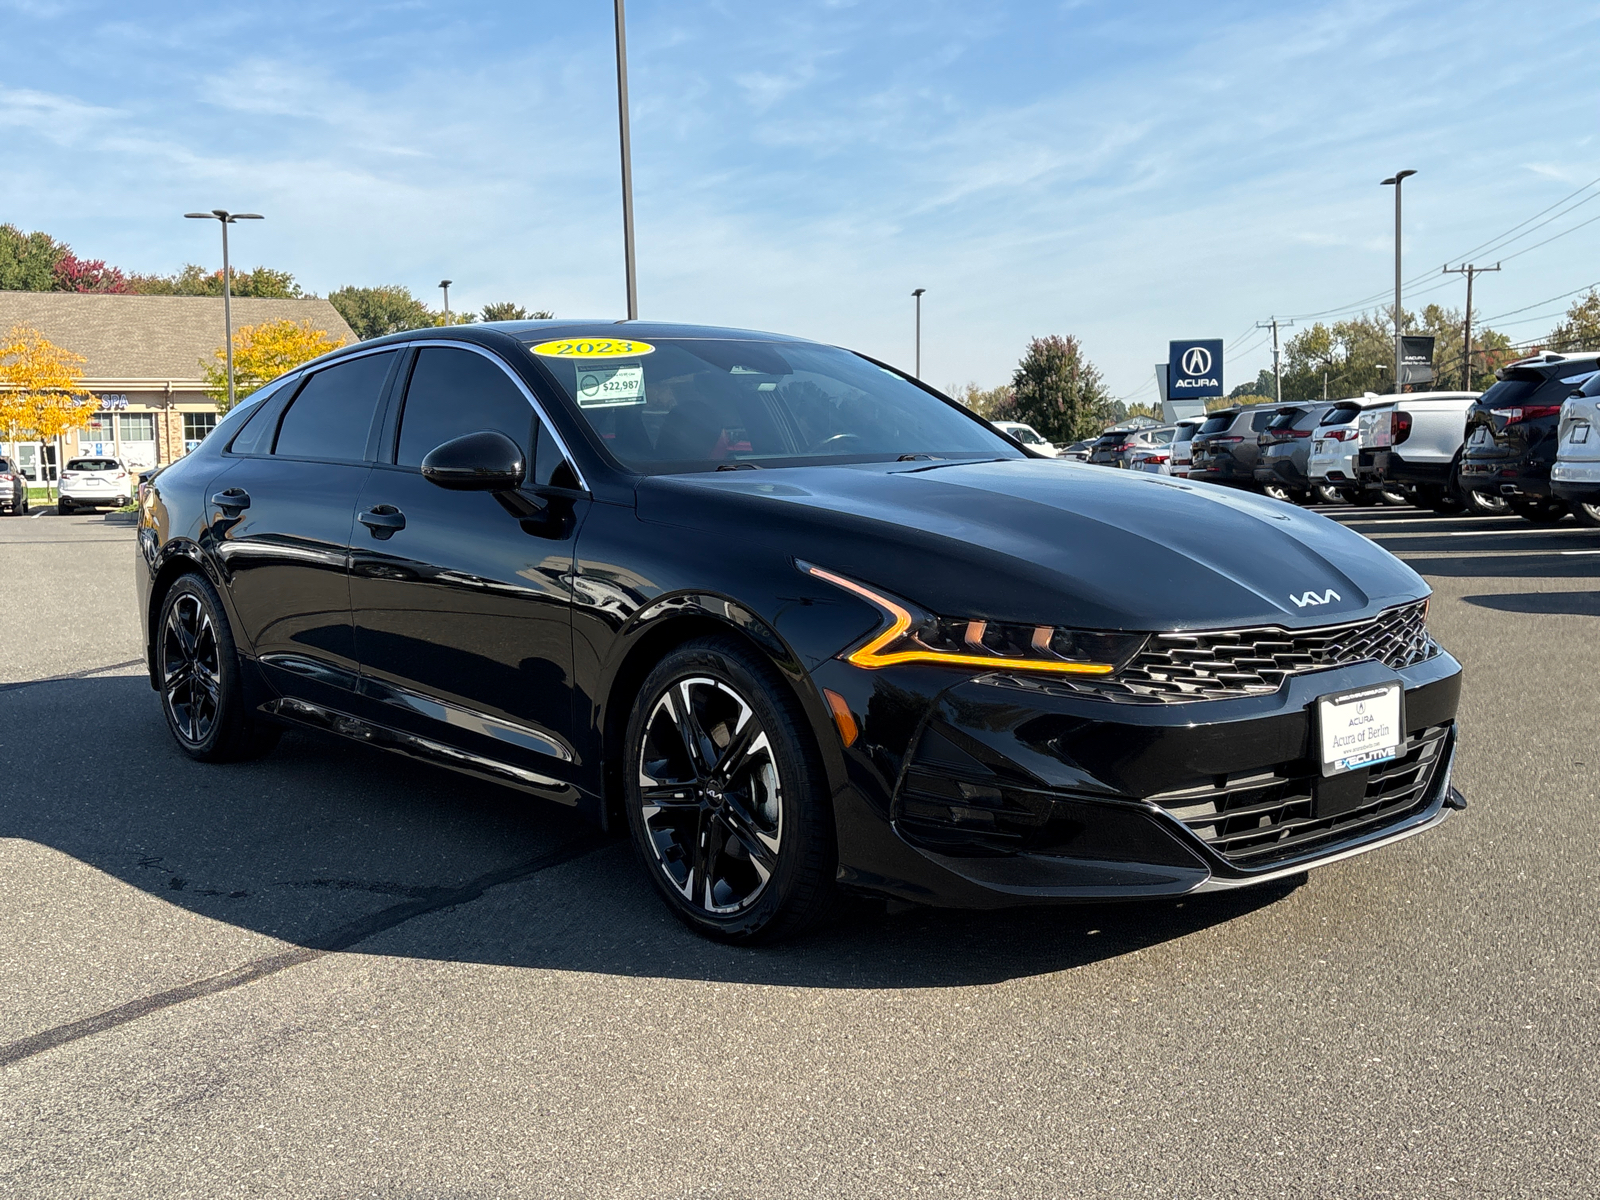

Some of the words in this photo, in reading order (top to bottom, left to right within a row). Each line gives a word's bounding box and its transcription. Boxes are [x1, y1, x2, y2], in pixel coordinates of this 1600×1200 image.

[556, 342, 633, 355] 2023
[603, 380, 639, 392] $22,987
[1175, 378, 1219, 388] ACURA
[101, 394, 129, 409] SPA
[1289, 588, 1341, 607] KIA
[1348, 714, 1375, 727] ACURA
[1332, 734, 1356, 748] Acura
[1357, 730, 1366, 742] of
[1367, 723, 1390, 740] Berlin
[1334, 746, 1396, 770] EXECUTIVE
